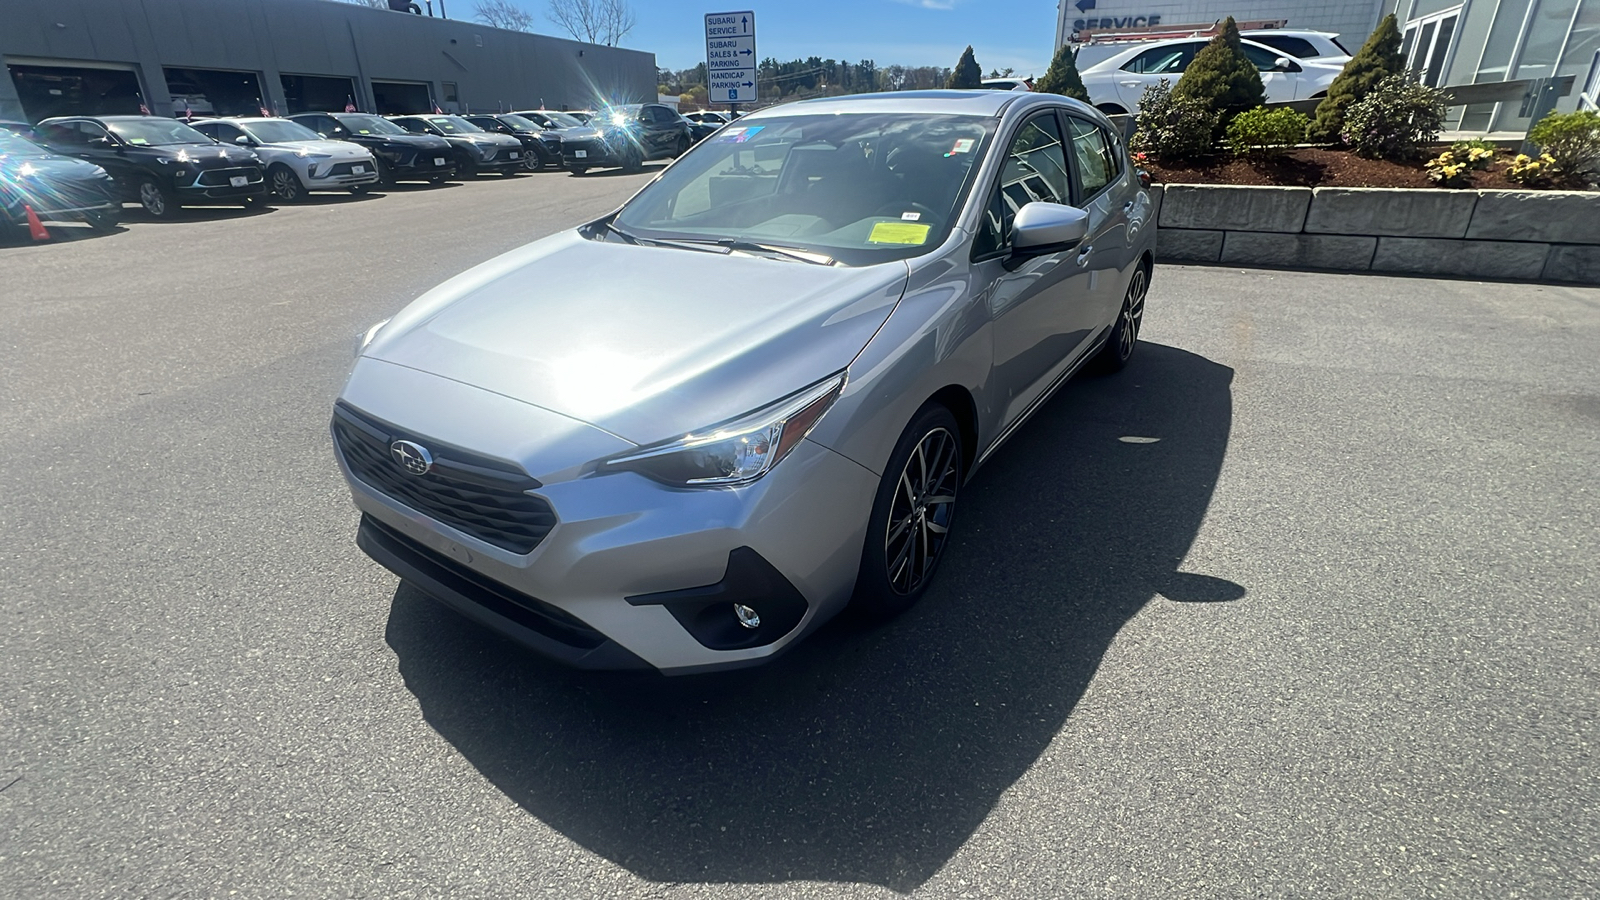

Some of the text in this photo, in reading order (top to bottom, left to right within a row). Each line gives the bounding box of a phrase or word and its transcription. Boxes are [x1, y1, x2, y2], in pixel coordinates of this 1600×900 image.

[708, 17, 736, 25] SUBARU
[709, 27, 737, 35] SERVICE
[709, 41, 737, 49] SUBARU
[710, 60, 740, 68] PARKING
[711, 72, 745, 80] HANDICAP
